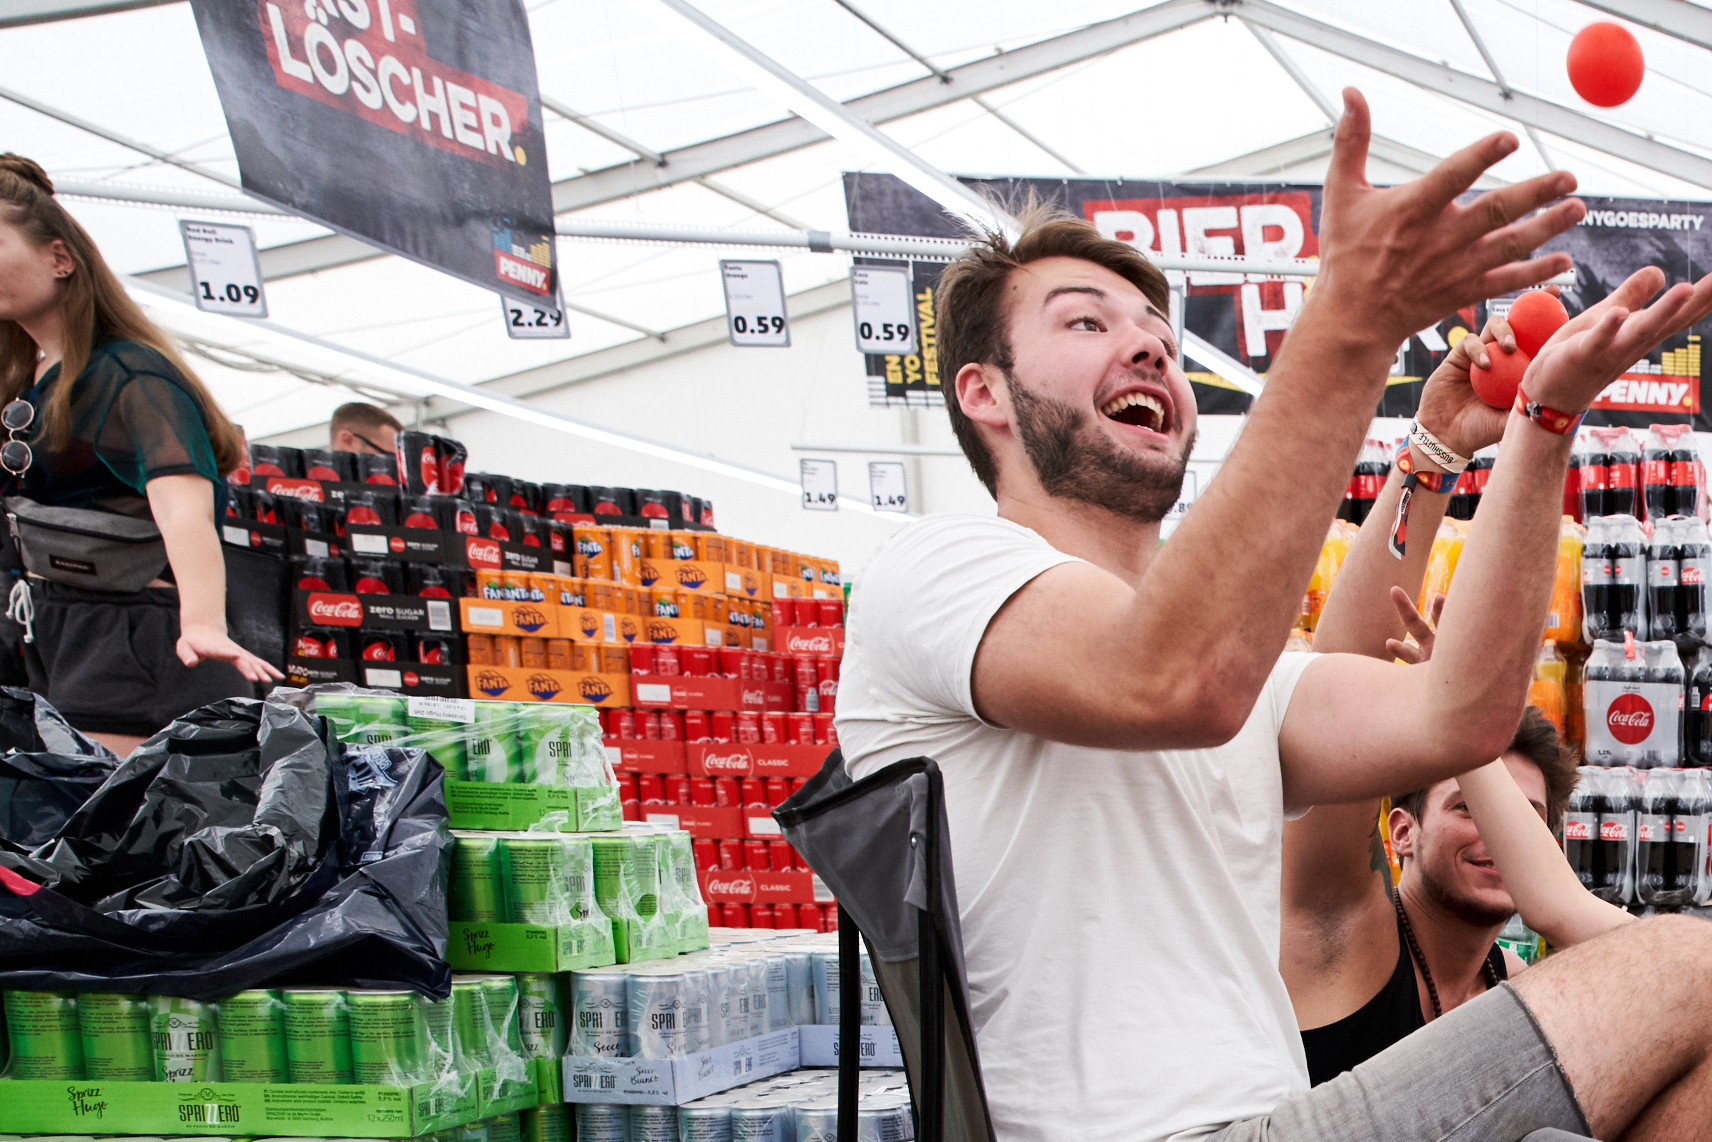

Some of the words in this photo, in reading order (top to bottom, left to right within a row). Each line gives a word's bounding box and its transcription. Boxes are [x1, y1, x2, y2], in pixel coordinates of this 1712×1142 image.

[266, 1, 527, 167] LÖSCHER.
[1576, 209, 1705, 231] NYGOESPARTY
[199, 281, 260, 304] 1.09
[510, 308, 563, 327] 2.29
[734, 315, 785, 335] 0.59
[860, 322, 910, 342] 0.59
[916, 286, 941, 386] FESTIVAL
[805, 492, 836, 505] 1.49
[875, 495, 906, 506] 1.49
[757, 758, 789, 767] CLASSIC
[760, 884, 791, 892] CLASSIC
[467, 941, 495, 959] Hugo
[67, 1085, 104, 1101] Sprizz
[73, 1100, 109, 1120] Hugo
